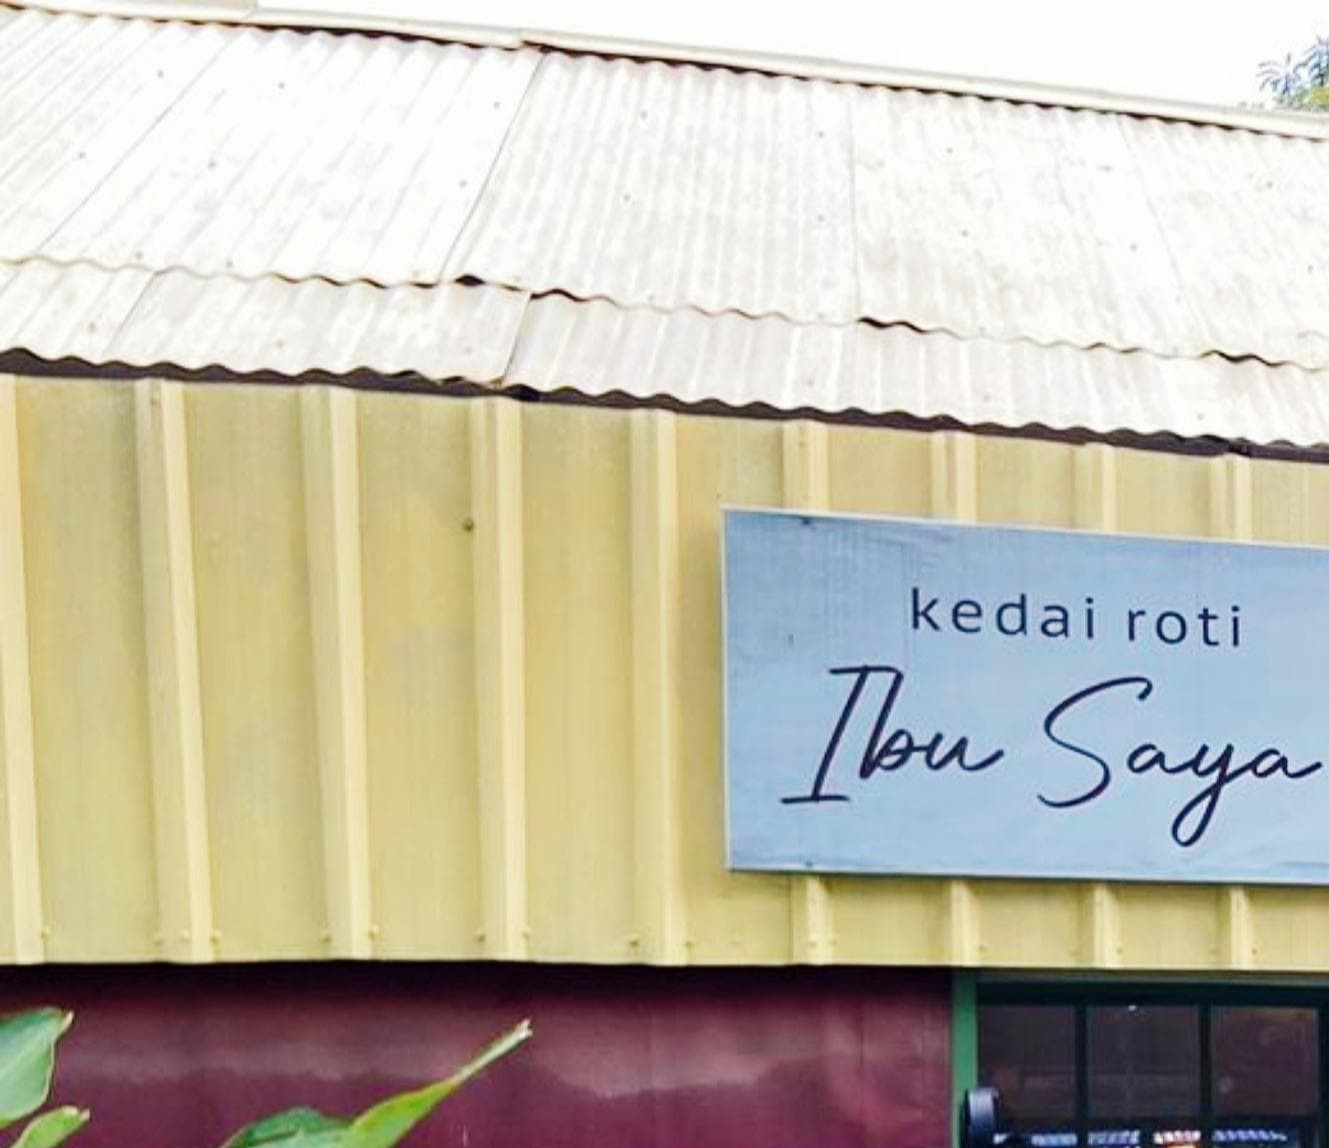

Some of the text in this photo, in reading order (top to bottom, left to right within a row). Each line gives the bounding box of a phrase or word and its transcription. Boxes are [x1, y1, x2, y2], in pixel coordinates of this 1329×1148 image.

[911, 586, 1240, 647] kedai roti
[781, 664, 1323, 848] Ibu Saya
